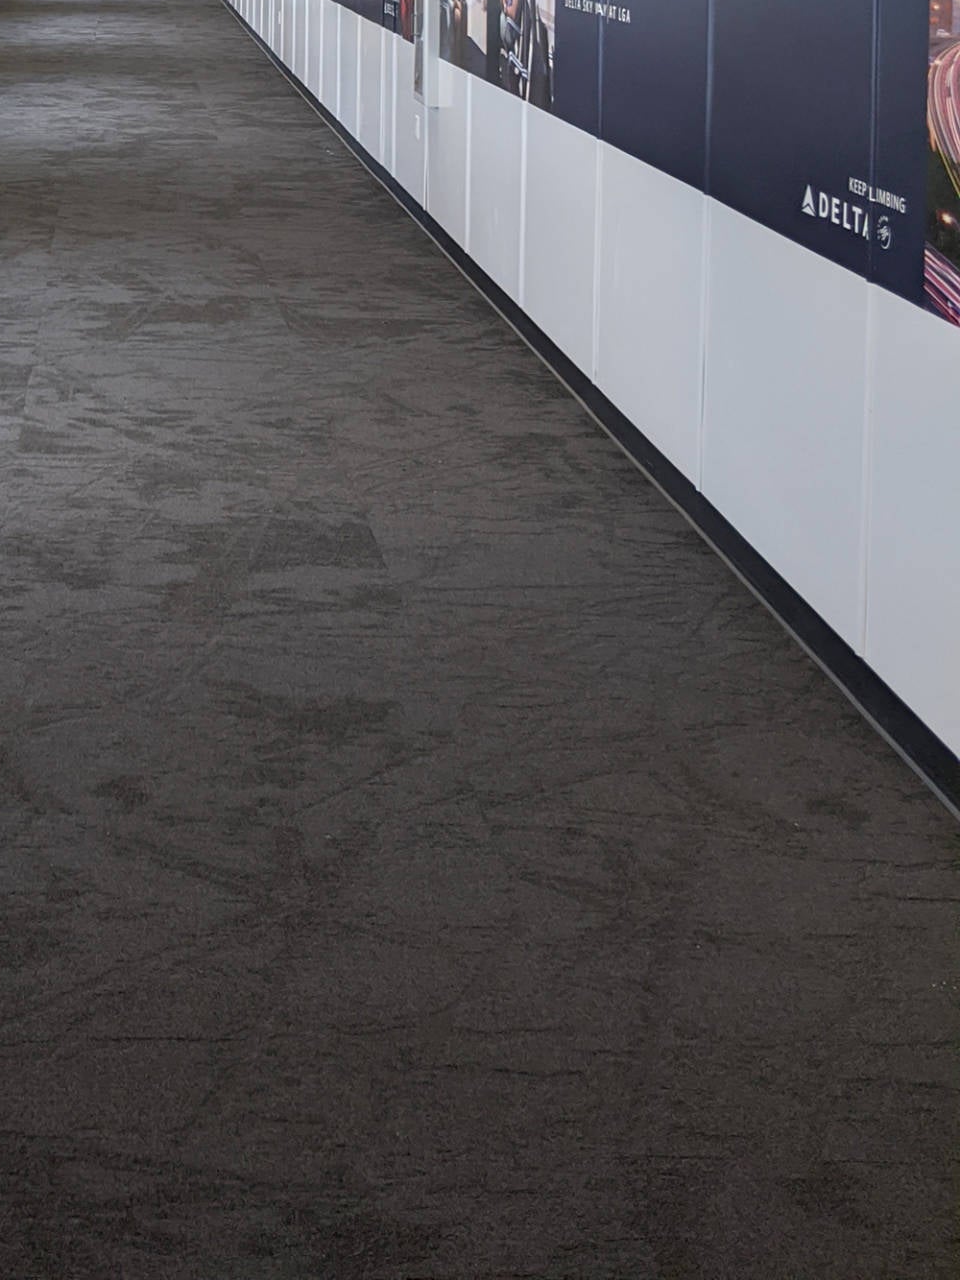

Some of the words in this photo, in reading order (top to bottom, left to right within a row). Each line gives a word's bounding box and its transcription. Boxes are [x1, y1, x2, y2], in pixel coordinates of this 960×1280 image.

[582, 0, 593, 14] SKY
[608, 5, 617, 20] AT
[618, 7, 631, 23] LGA
[848, 177, 867, 197] KEEP
[867, 186, 906, 214] LIMBING
[819, 191, 869, 241] DELTA
